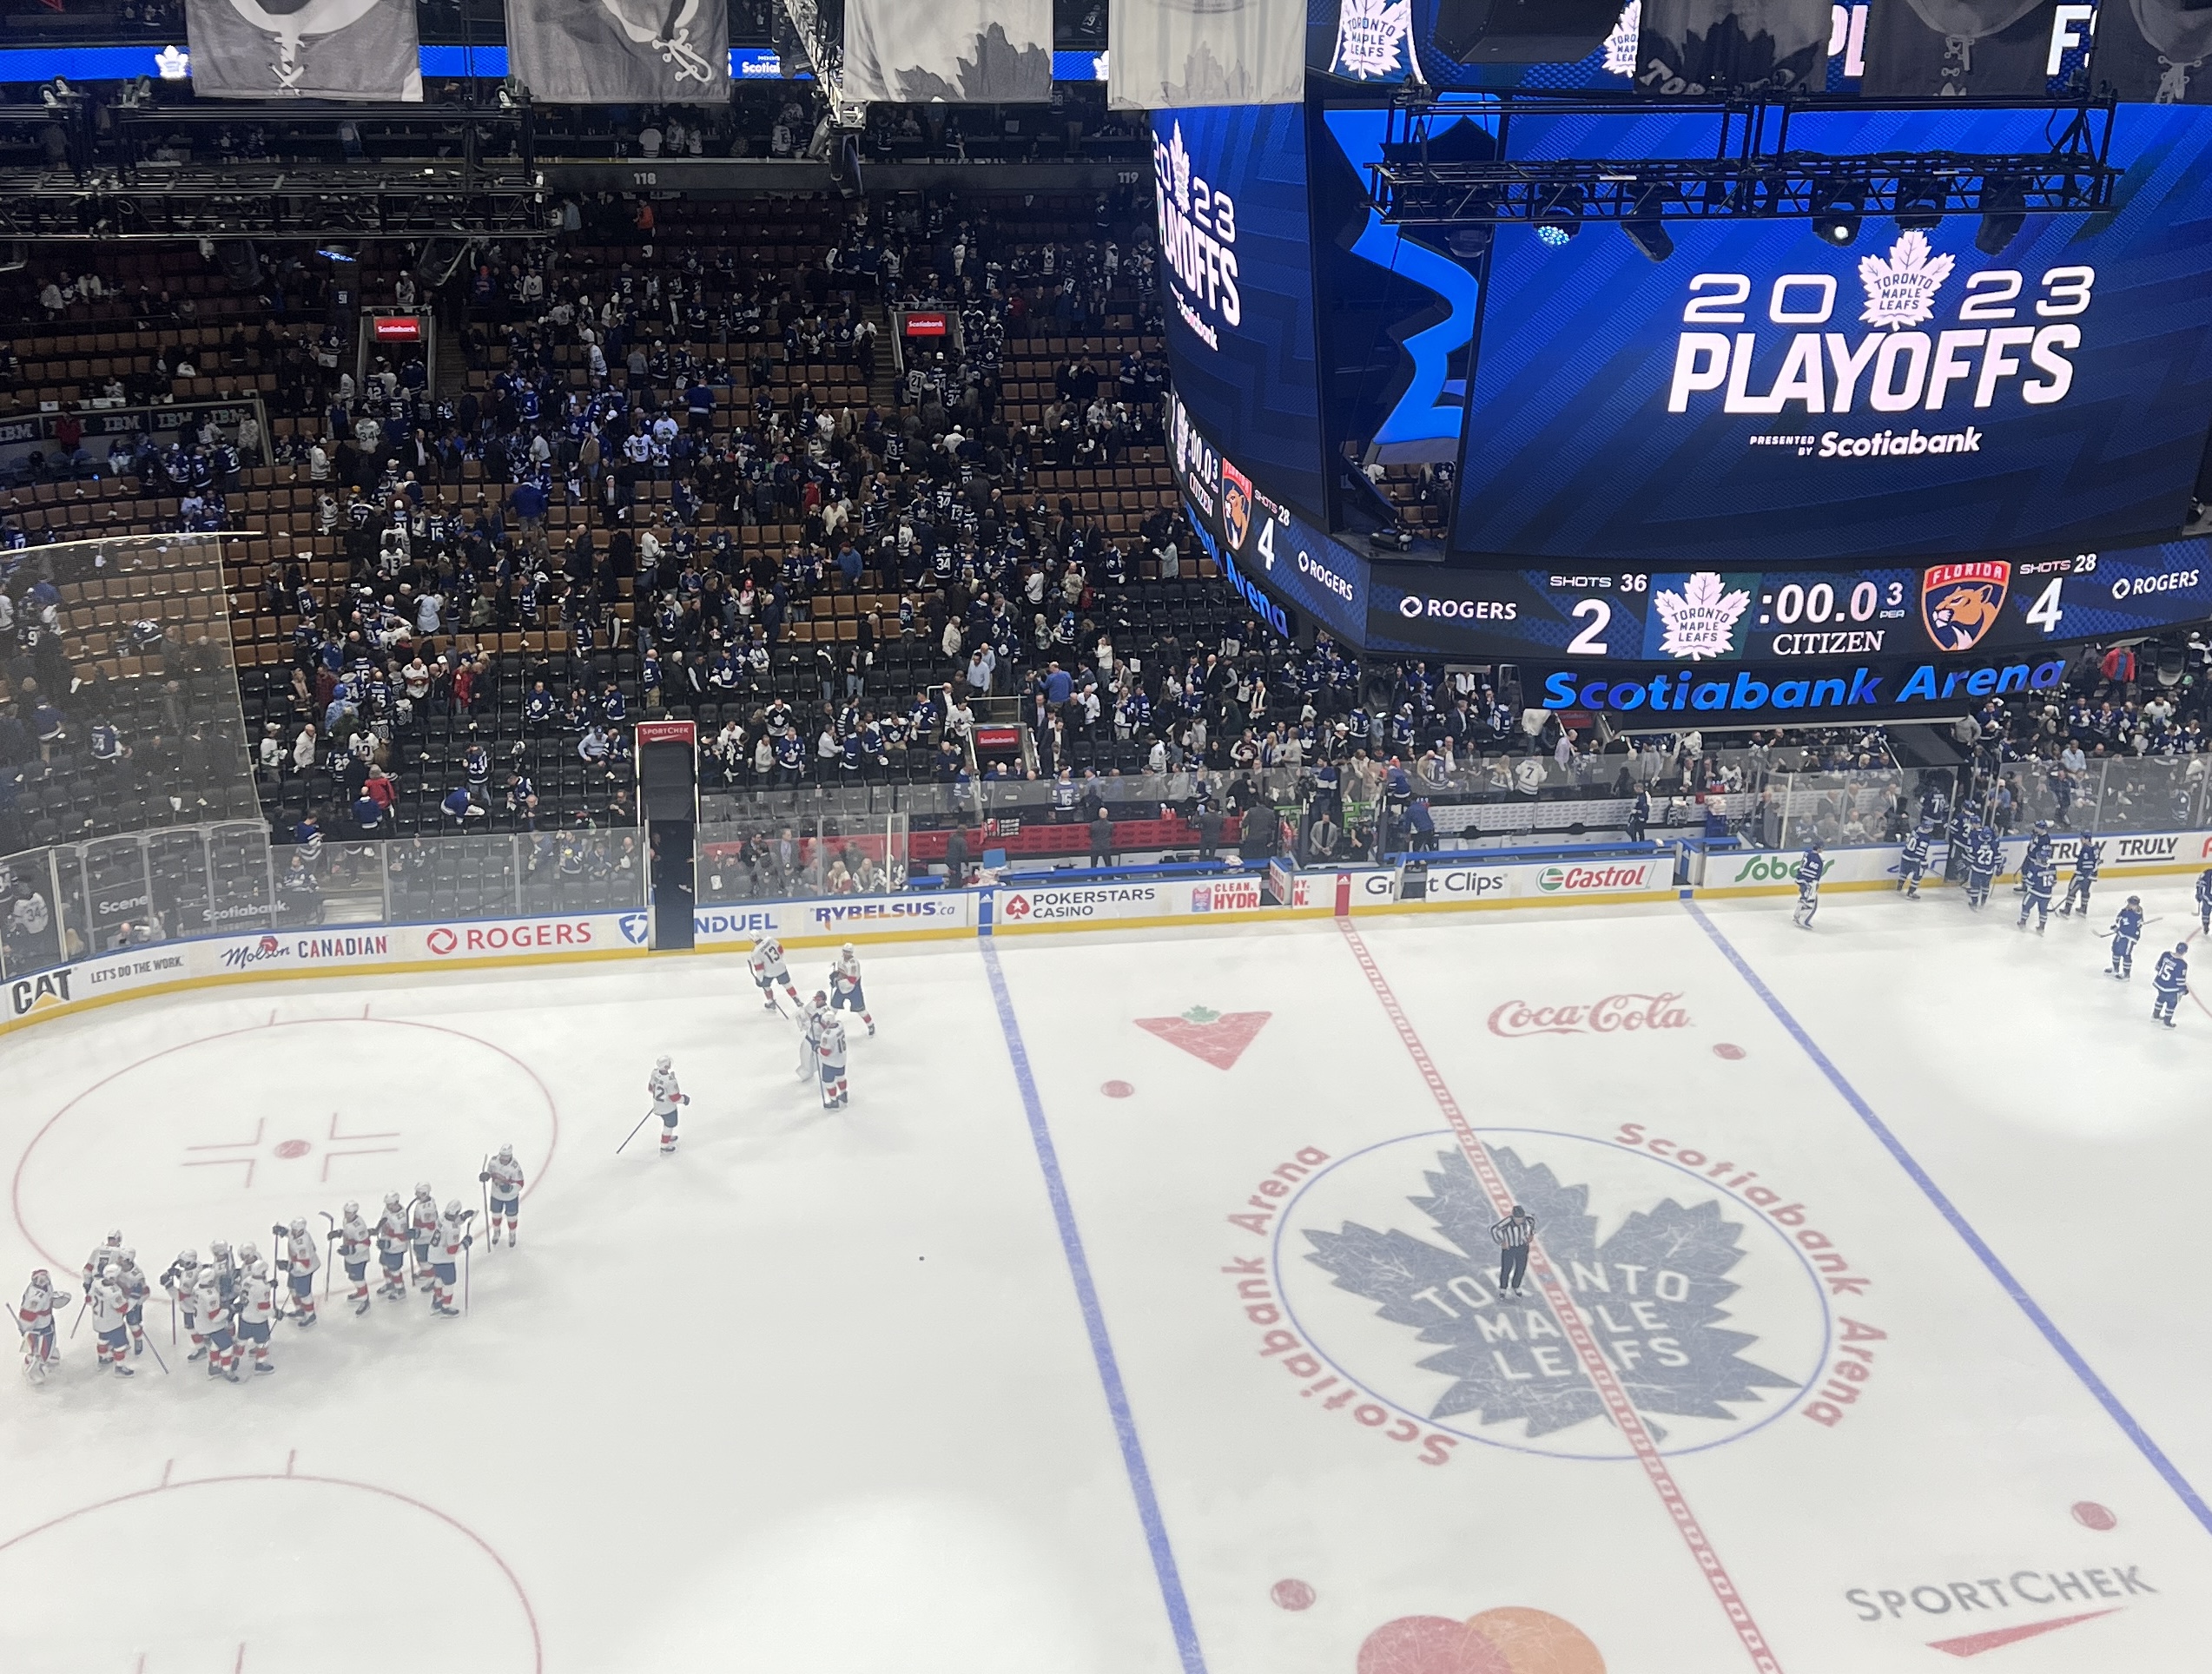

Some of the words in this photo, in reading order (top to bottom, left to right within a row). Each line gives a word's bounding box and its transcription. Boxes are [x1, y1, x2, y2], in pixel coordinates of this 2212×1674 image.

[1348, 16, 1396, 36] TORONTO
[1351, 32, 1385, 45] MAPLE
[1611, 33, 1638, 44] TORO
[1350, 43, 1384, 57] LEAFS
[742, 62, 781, 74] Scotia
[633, 172, 657, 185] 118
[1117, 171, 1139, 184] 119
[1193, 175, 1236, 244] 23
[1155, 176, 1241, 326] PLAYOFFS
[1873, 273, 1933, 290] TORONTO
[1682, 273, 1838, 324] 20
[1958, 265, 2096, 320] 23
[1881, 288, 1922, 299] MAPLE
[1879, 300, 1919, 310] LEAFS
[377, 325, 417, 333] Scotiabank
[908, 320, 944, 329] Scotiabank
[1667, 323, 2083, 414] PLAYOFFS
[0, 423, 34, 442] IBM
[102, 415, 141, 432] IBM
[1750, 435, 1815, 445] PRESENTED
[1818, 426, 1983, 458] Scotiabank
[1798, 447, 1813, 457] BY
[1278, 504, 1291, 527] 28
[1258, 517, 1275, 571] 4
[936, 557, 951, 571] 34
[1932, 563, 2003, 584] FLORIDA
[2019, 560, 2071, 575] SHOTS
[2074, 553, 2097, 573] 28
[1310, 559, 1353, 602] ROGERS
[1549, 575, 1612, 588] SHOTS
[1620, 573, 1647, 592] 36
[2133, 569, 2200, 596] ROGERS
[1225, 550, 1290, 640] Arena
[1886, 581, 1903, 606] 3
[1427, 599, 1517, 621] ROGERS
[1671, 607, 1730, 623] TORONTO
[1879, 610, 1905, 619] PER
[2025, 577, 2063, 633] 4
[1566, 597, 1612, 655] 2
[1678, 632, 1718, 642] LEAFS
[1680, 622, 1720, 631] MAPLE
[1773, 629, 1885, 656] CITIZEN
[1542, 666, 1885, 712] Scotiabank
[1896, 659, 2067, 702] Arena
[1977, 850, 1994, 866] 23
[2118, 837, 2179, 857] TRULY
[1214, 882, 1254, 893] CLEAN.
[1444, 872, 1503, 895] Clips
[1564, 865, 1646, 889] Castrol
[99, 895, 149, 915] Scene
[1033, 887, 1155, 906] POKERSTARS
[1033, 905, 1093, 919] CASINO
[694, 913, 779, 934] NDUEL
[298, 935, 388, 959] CANADIAN
[467, 922, 592, 951] ROGERS
[221, 942, 289, 968] Molson
[764, 946, 780, 965] 13
[91, 968, 116, 984] LET'S
[118, 965, 131, 978] DO
[134, 960, 152, 974] THE
[12, 967, 73, 1015] CAT
[1487, 992, 1691, 1038] Coca-Cola
[1227, 1145, 1331, 1237] Arena
[1614, 1123, 1872, 1296] Scotiabank
[1410, 1260, 1690, 1320] TONTO
[1220, 1256, 1461, 1467] Scotiabank
[1492, 1337, 1691, 1381] LEFS
[1800, 1315, 1888, 1428] Arena
[1846, 1565, 2159, 1623] SPORTCHEK
